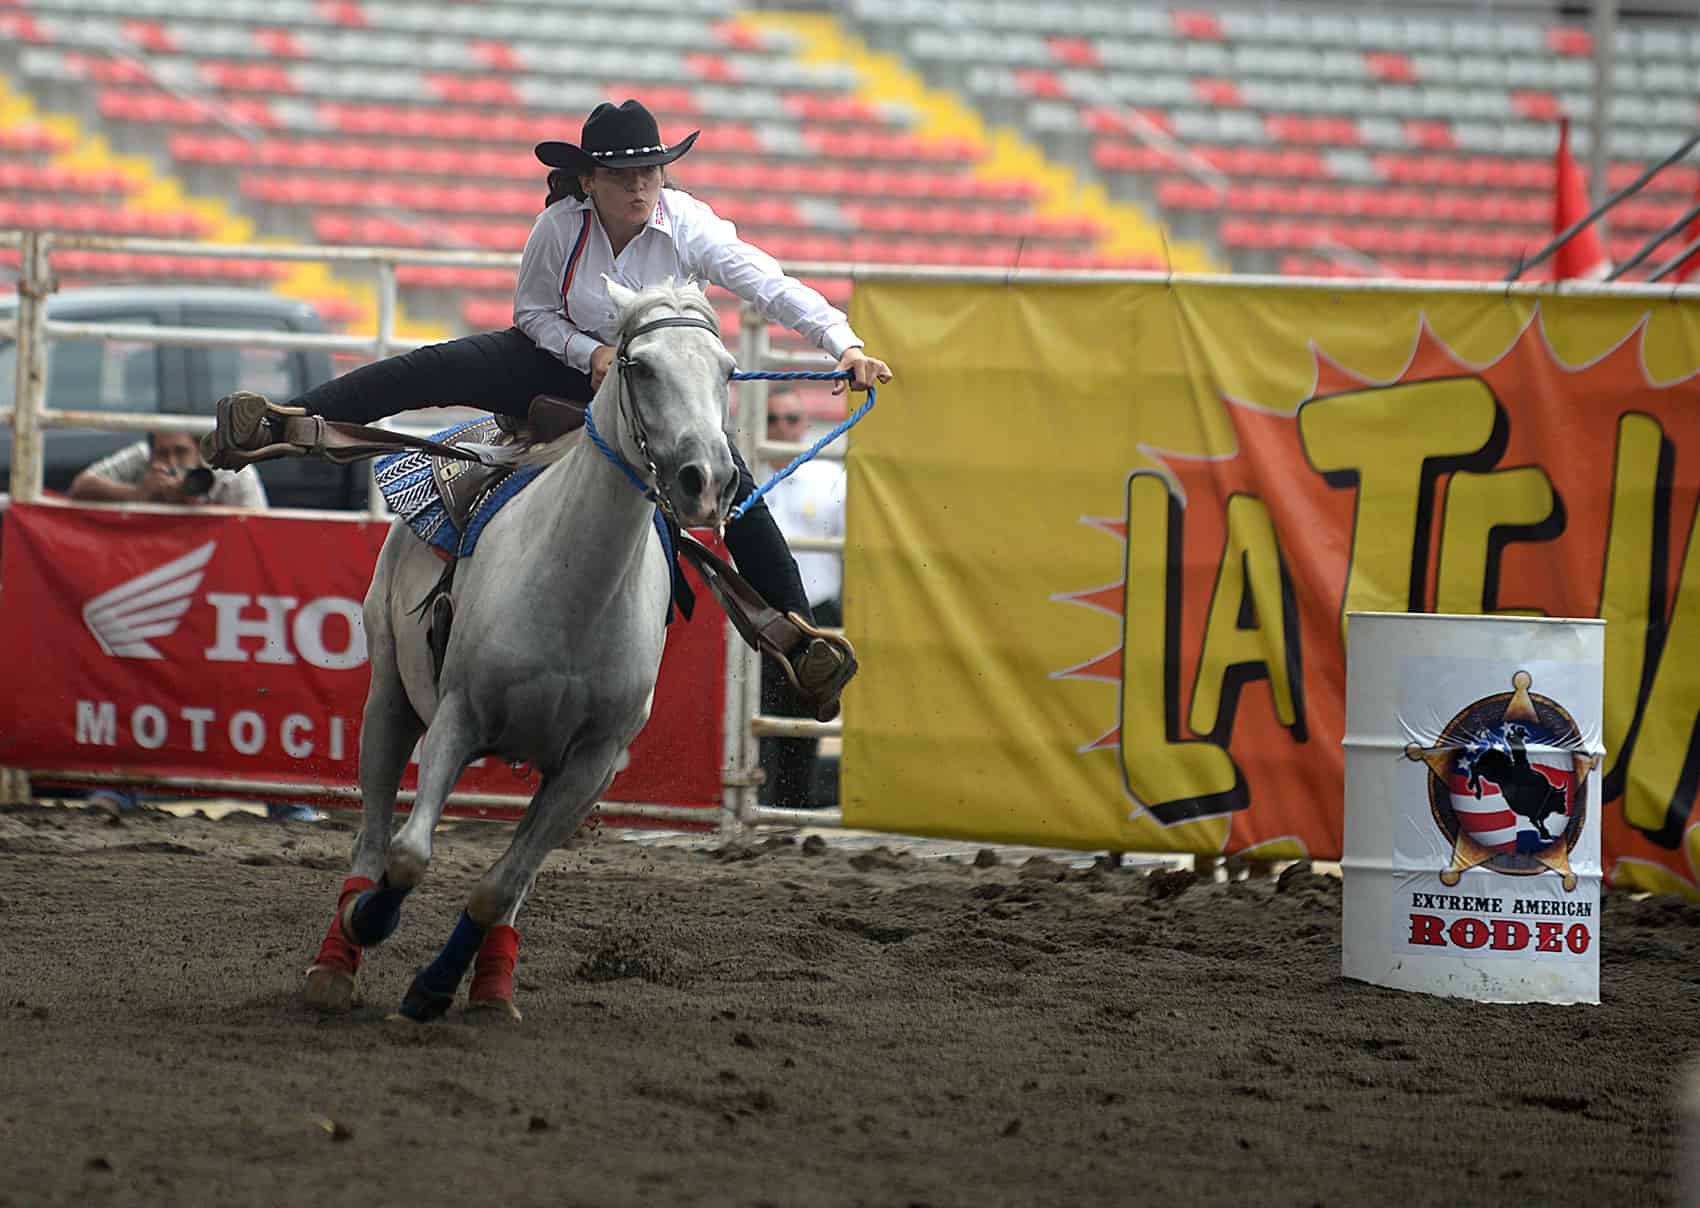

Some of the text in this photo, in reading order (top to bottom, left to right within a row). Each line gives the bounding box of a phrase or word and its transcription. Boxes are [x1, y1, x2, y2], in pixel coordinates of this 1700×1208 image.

[204, 592, 369, 670] HO
[75, 700, 345, 761] MOTOCI
[1412, 892, 1592, 917] EXTREME AMERICAN
[1408, 913, 1592, 954] RODEO
